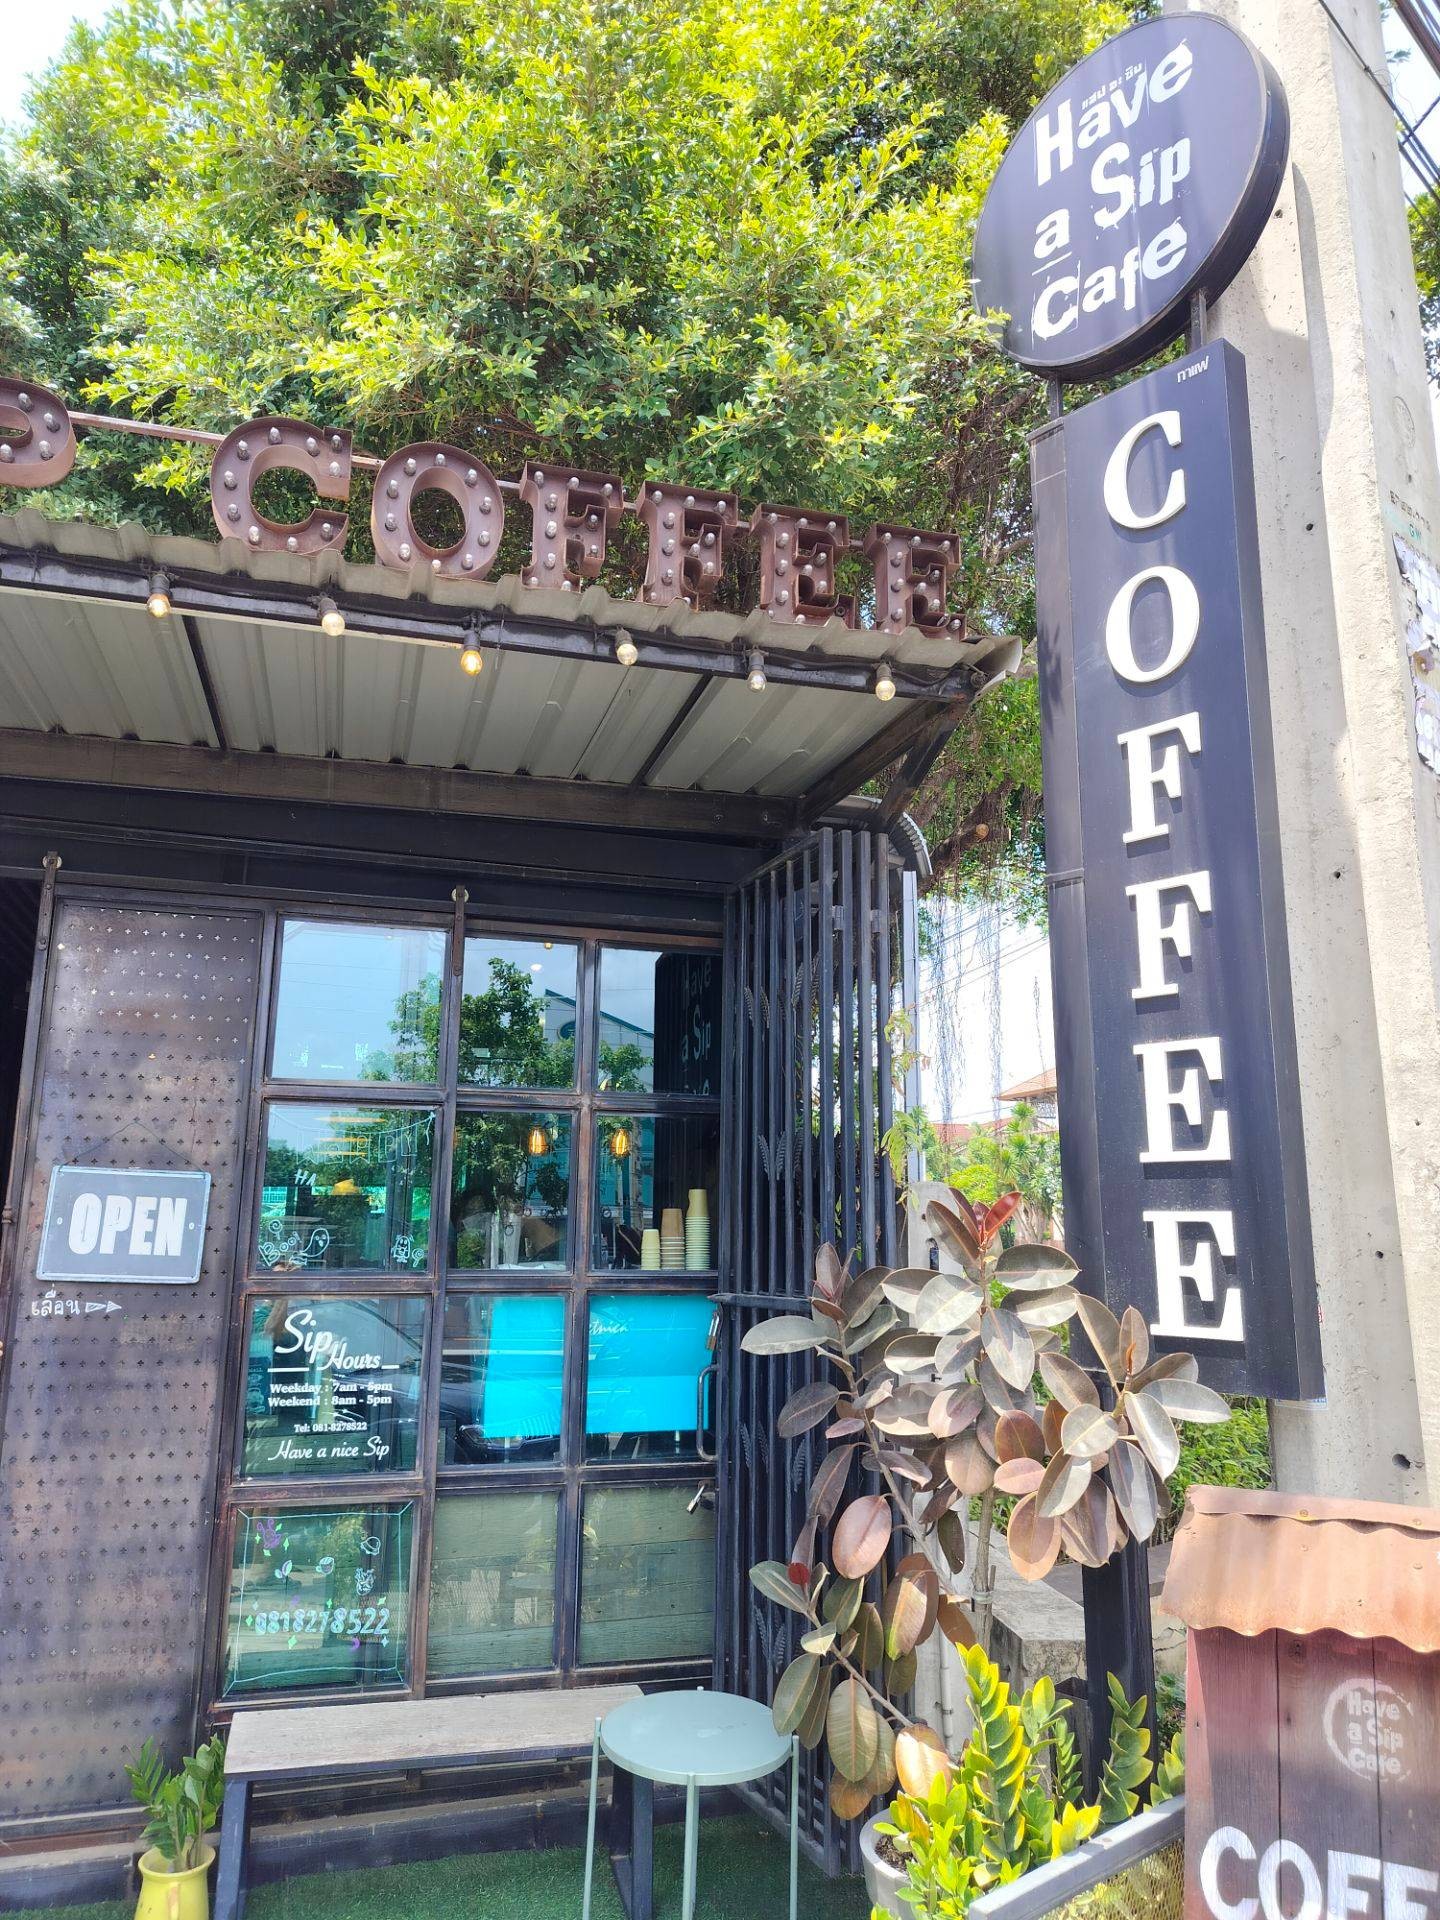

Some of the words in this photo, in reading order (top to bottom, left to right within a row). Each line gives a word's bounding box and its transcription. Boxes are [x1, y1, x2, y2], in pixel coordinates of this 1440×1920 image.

[1034, 41, 1194, 188] Have
[1033, 208, 1070, 260] a
[1090, 137, 1192, 230] Sip
[1177, 355, 1209, 383] กาแฟ
[211, 415, 967, 642] COFFEE
[1103, 410, 1245, 1343] COFFEE
[68, 1192, 188, 1256] OPEN
[31, 1283, 80, 1316] เลื่อน
[274, 1309, 332, 1363] Sip
[317, 1340, 382, 1370] Hours
[268, 1396, 321, 1407] Weekend
[331, 1396, 356, 1406] 8am
[366, 1395, 392, 1407] 5pm
[269, 1383, 322, 1396] Weekday
[332, 1383, 358, 1392] 7am
[268, 1440, 312, 1461] Have
[316, 1447, 326, 1458] a
[331, 1442, 359, 1458] nice
[363, 1436, 390, 1460] Sip
[1346, 1691, 1401, 1720] Have
[1347, 1722, 1362, 1741] a
[1366, 1717, 1404, 1754] Sip
